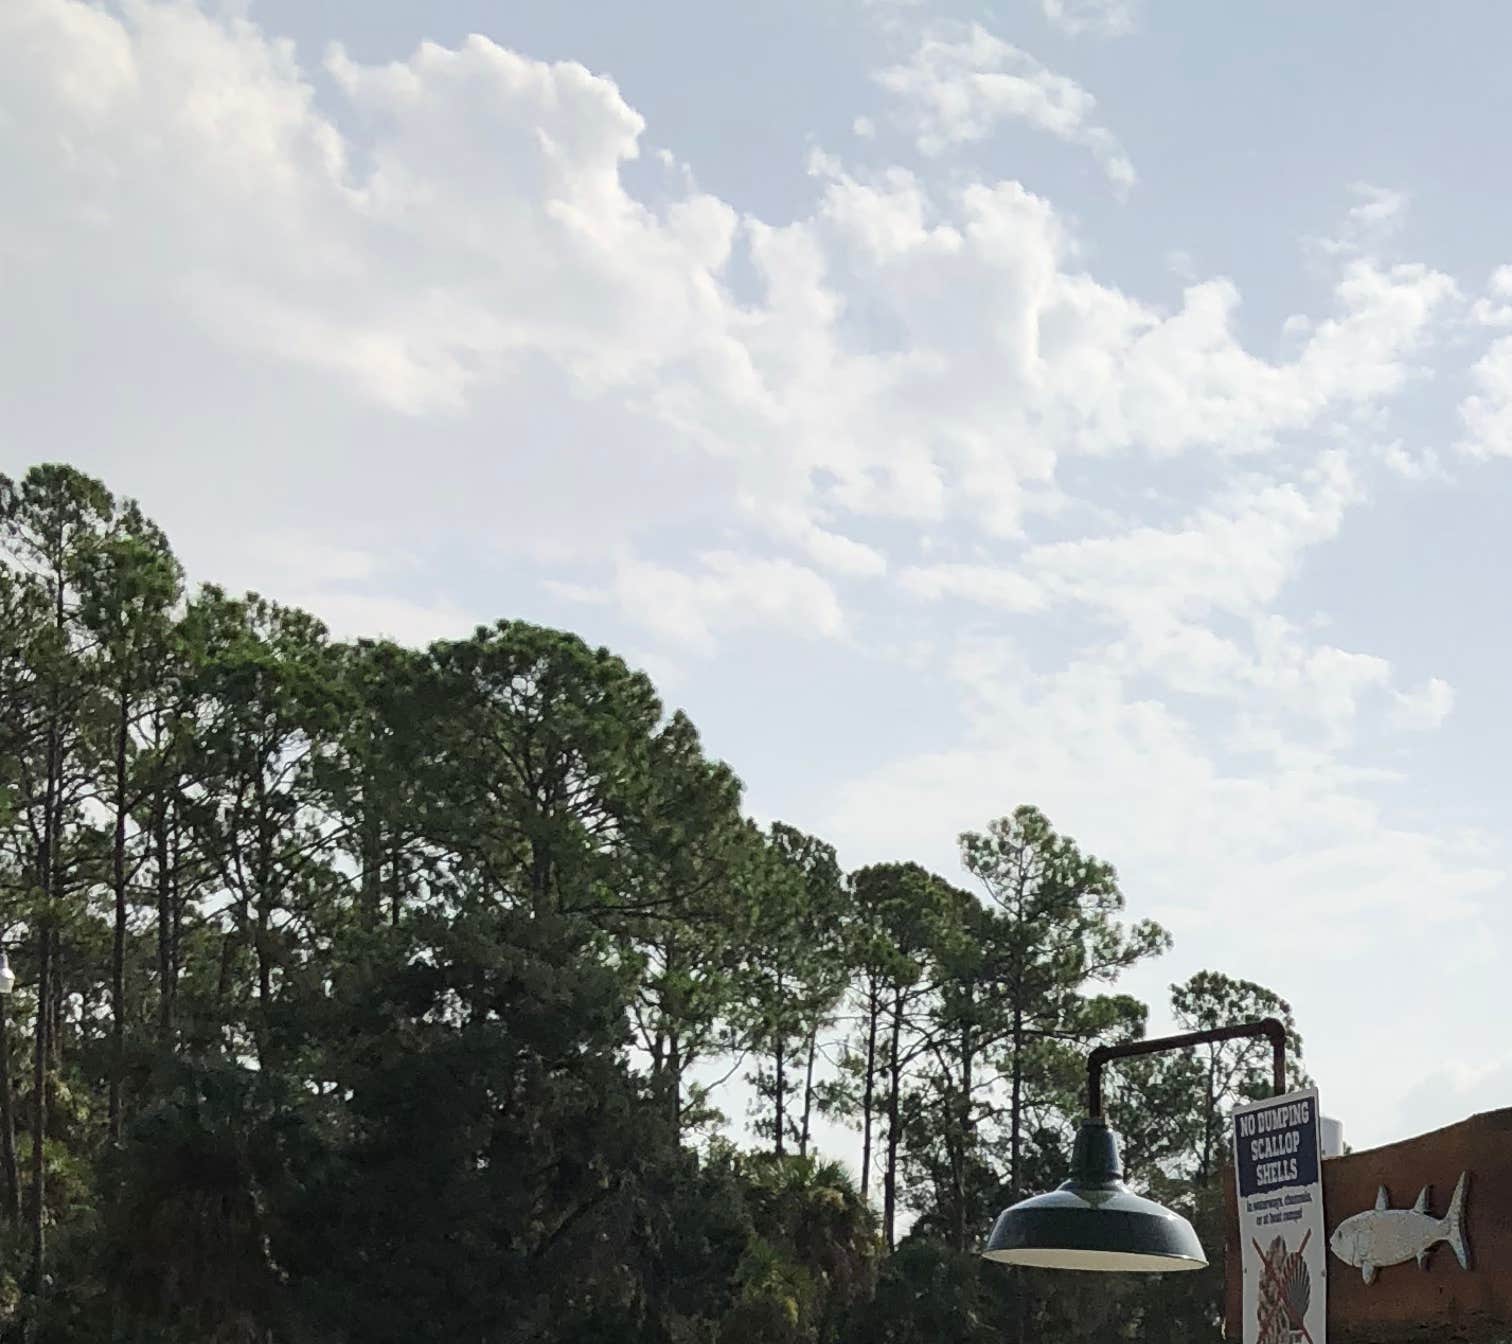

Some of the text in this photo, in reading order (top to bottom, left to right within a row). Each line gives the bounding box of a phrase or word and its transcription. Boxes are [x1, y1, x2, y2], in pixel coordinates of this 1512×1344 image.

[1240, 1101, 1309, 1137] NO DUMPING
[1251, 1131, 1299, 1161] SCALLOP
[1257, 1158, 1297, 1186] SHELLS
